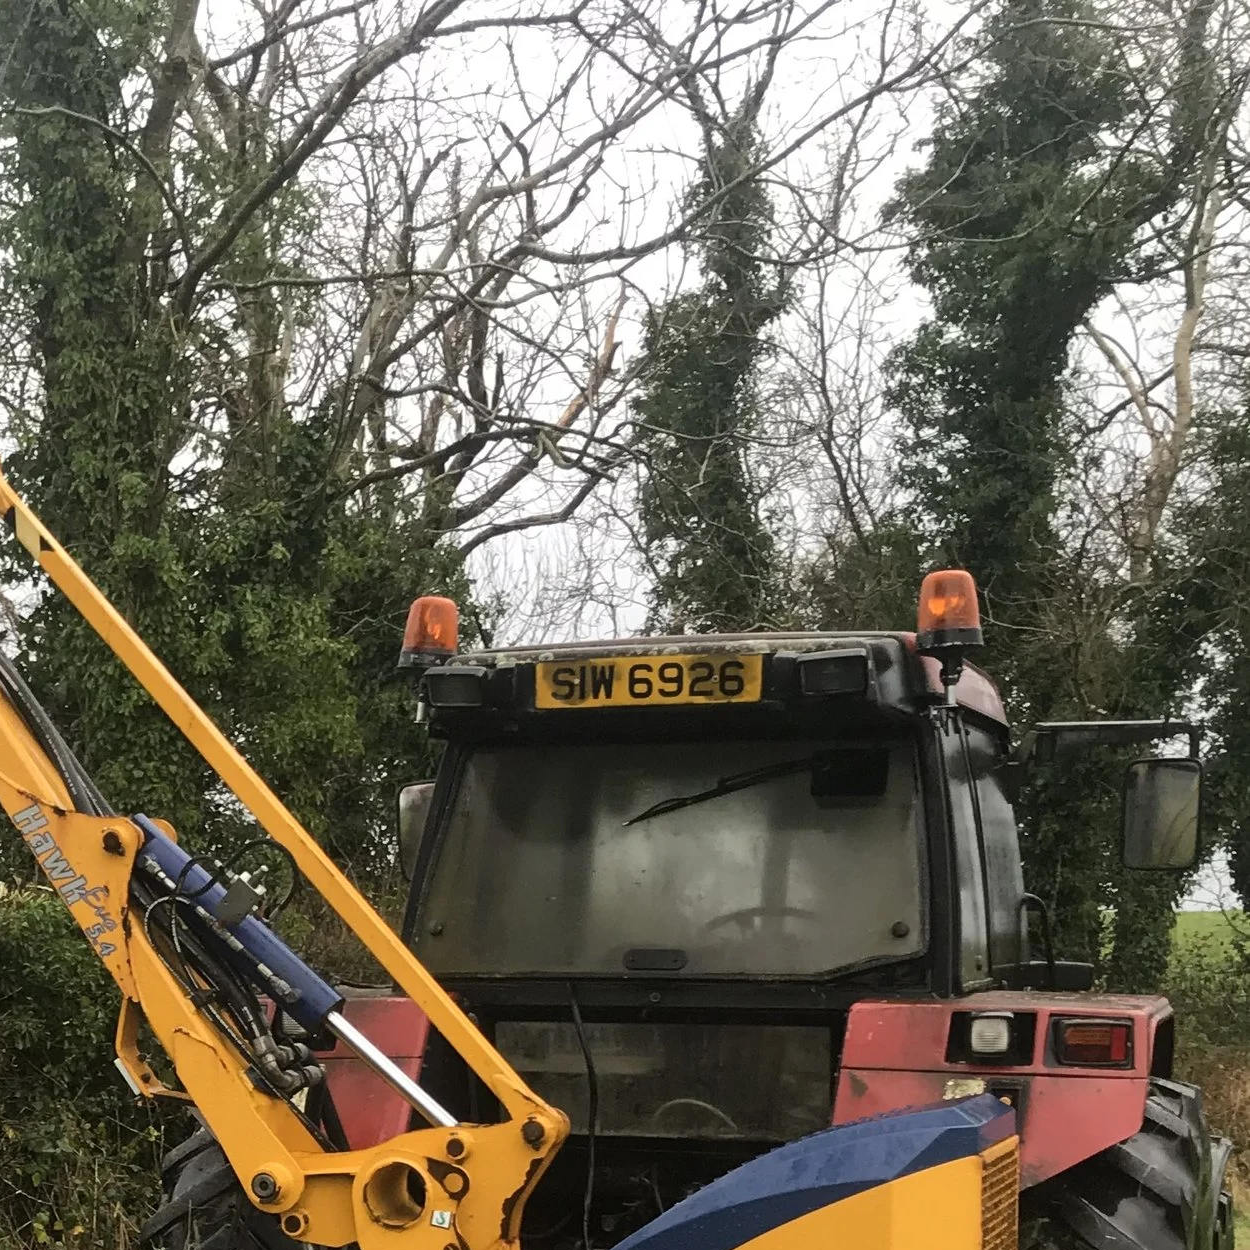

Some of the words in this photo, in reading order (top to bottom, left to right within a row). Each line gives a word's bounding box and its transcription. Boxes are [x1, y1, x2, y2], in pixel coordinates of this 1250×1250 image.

[551, 665, 614, 701] SIW
[628, 661, 745, 699] 6926
[12, 803, 88, 907] Hawk
